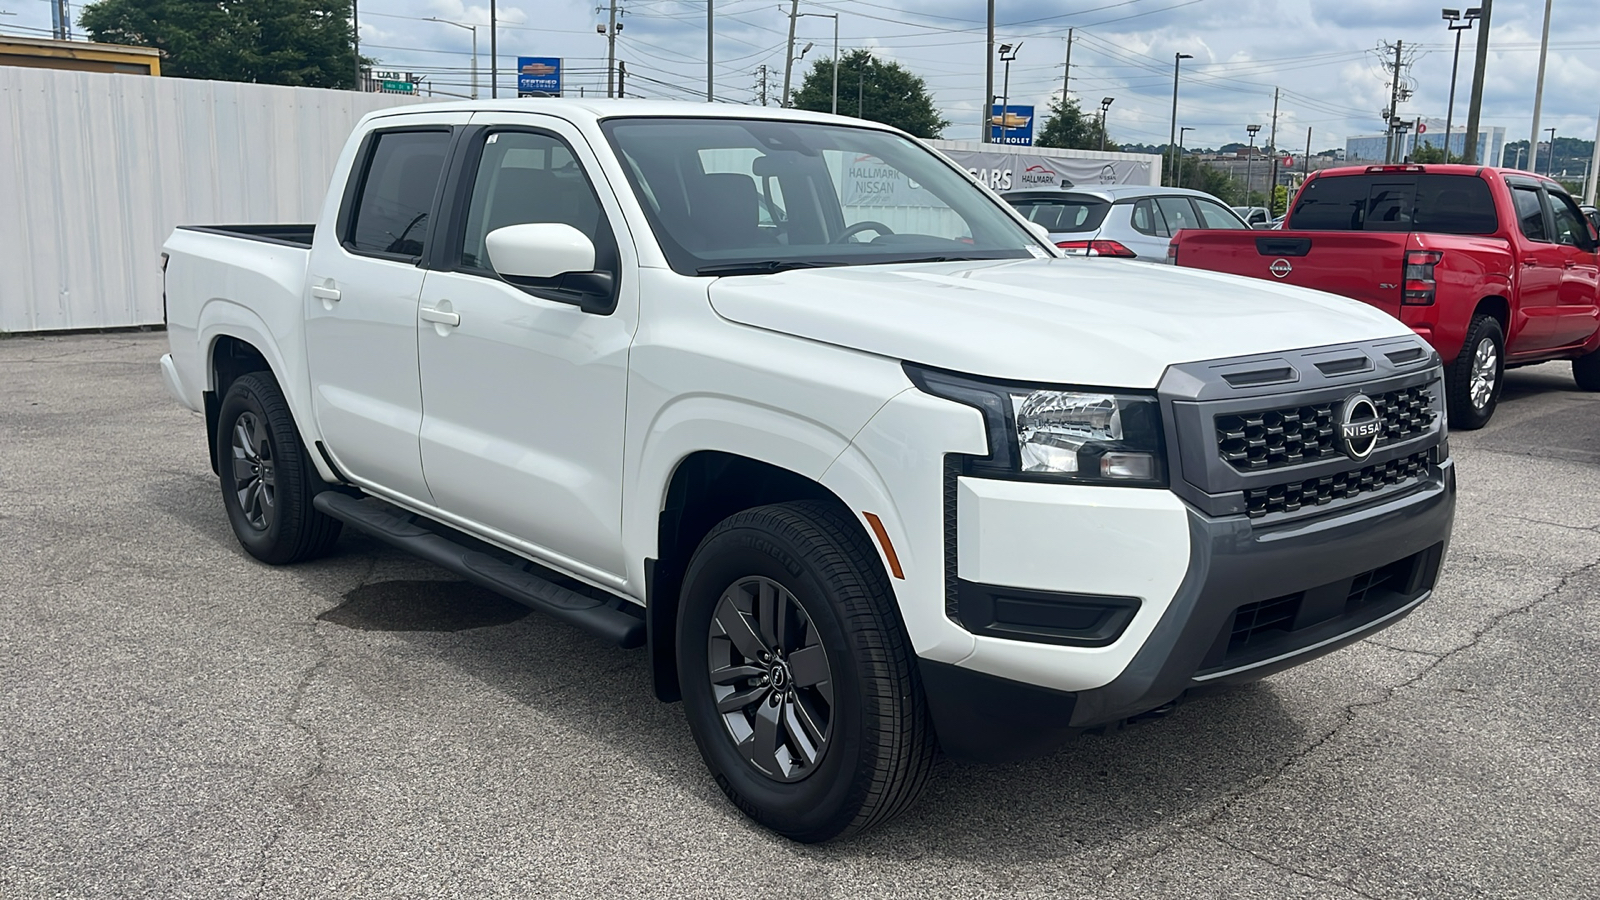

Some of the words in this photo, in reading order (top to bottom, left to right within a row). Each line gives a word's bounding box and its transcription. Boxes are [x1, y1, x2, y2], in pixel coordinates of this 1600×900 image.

[849, 168, 900, 180] HALLMARK
[1022, 175, 1054, 184] HALLMARK
[855, 181, 895, 194] NISSAN
[1343, 422, 1381, 437] NISSA
[741, 534, 800, 575] MICHELIN
